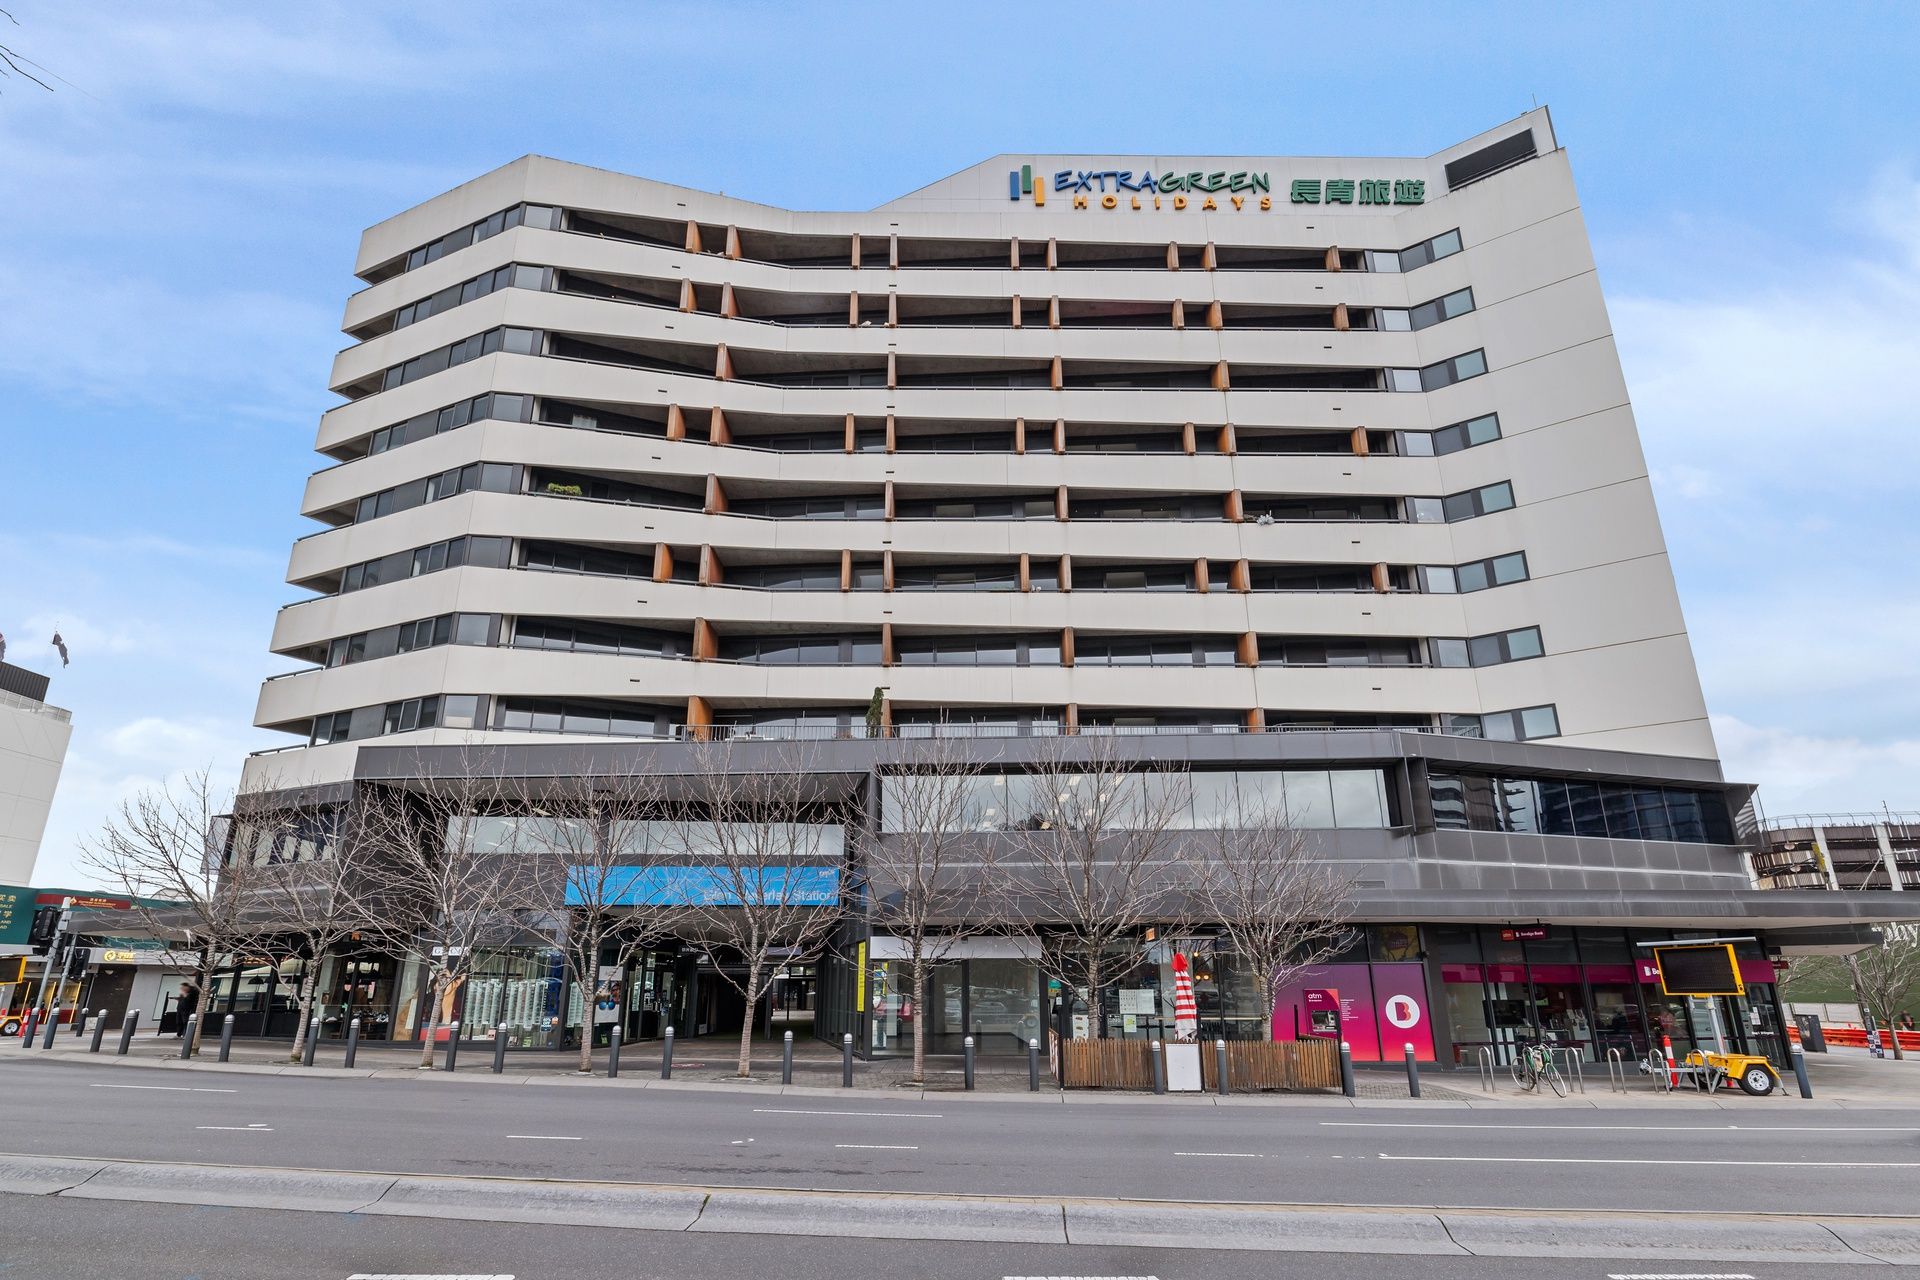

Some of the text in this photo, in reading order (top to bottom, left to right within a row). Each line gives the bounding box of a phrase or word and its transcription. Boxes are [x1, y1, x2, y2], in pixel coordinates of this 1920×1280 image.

[1054, 170, 1270, 193] EXTRAGREEN
[1291, 179, 1425, 204] 長青旅遊
[1073, 195, 1272, 210] HOLIDAYS
[794, 889, 836, 902] Station
